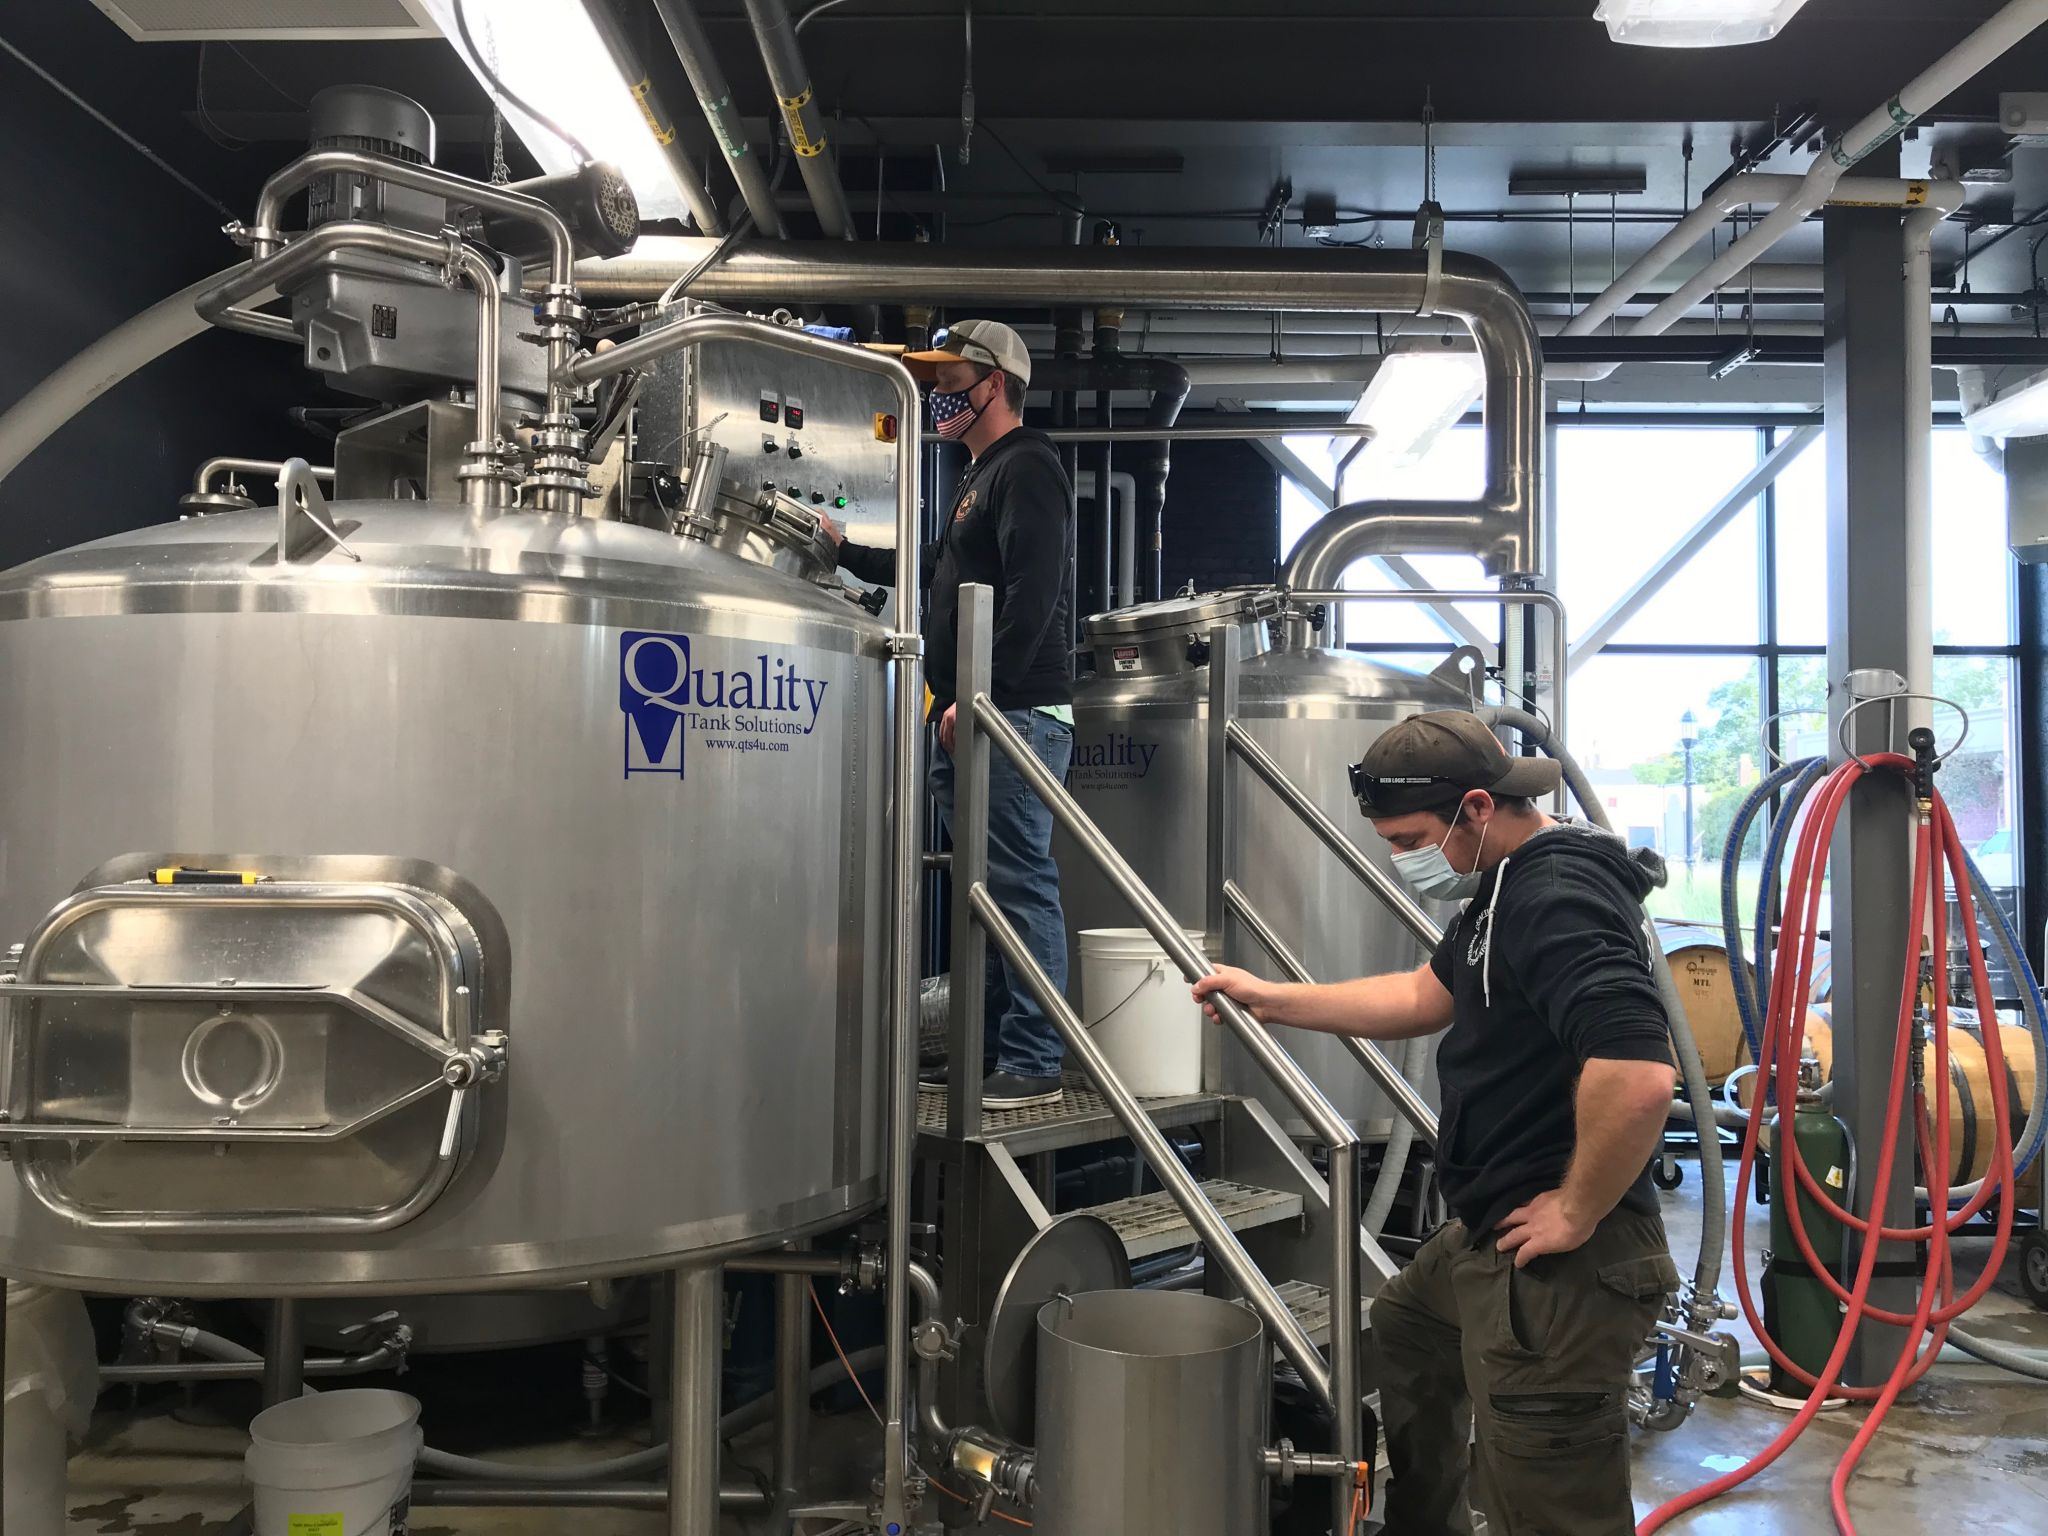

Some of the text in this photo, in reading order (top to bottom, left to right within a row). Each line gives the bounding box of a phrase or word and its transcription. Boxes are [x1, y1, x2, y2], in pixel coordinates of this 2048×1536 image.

[624, 637, 829, 735] Quality
[688, 713, 801, 734] Tank Solutions
[705, 739, 789, 753] www.qts4u.com
[1074, 733, 1159, 778] uality
[1074, 770, 1136, 780] Tank Solutions
[1693, 978, 1711, 987] MTL
